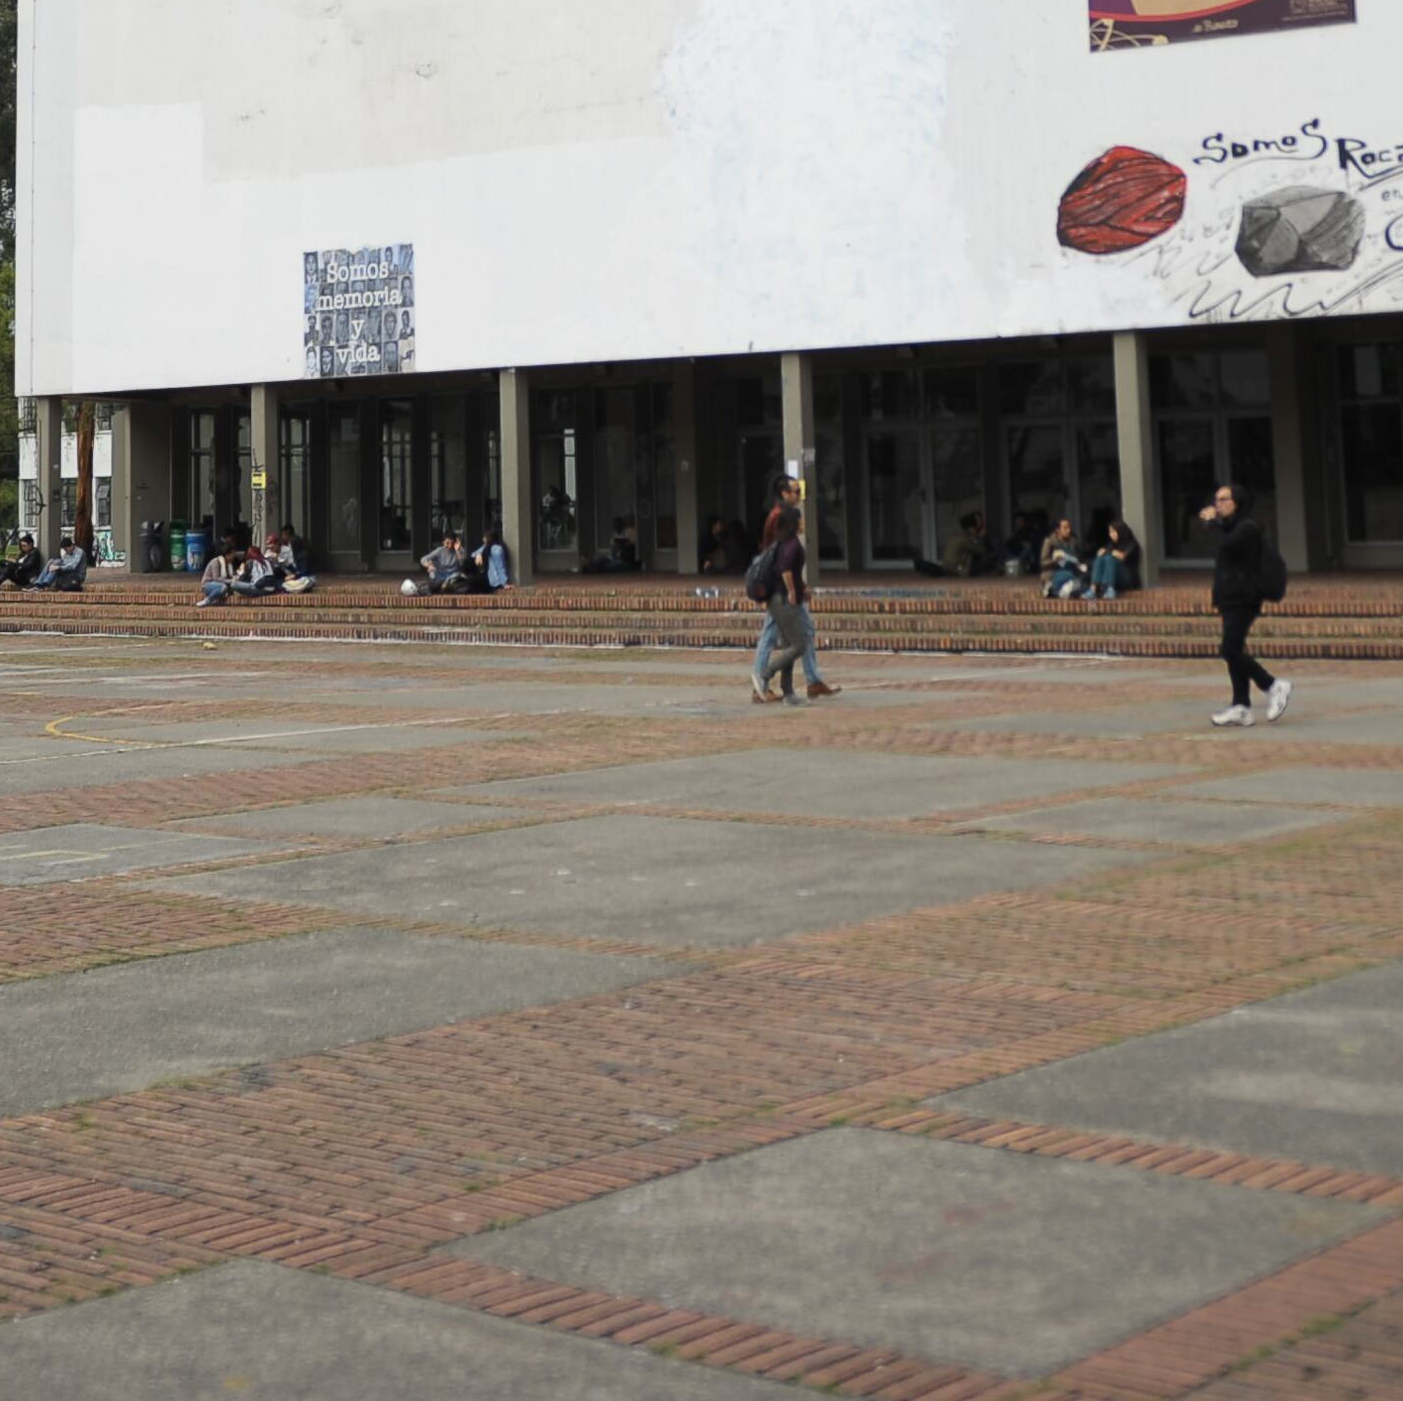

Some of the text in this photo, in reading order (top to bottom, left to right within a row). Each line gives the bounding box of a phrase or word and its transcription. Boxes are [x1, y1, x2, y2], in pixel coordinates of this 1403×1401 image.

[1381, 188, 1403, 202] en
[326, 261, 389, 283] Somos
[315, 286, 403, 311] memoria
[351, 319, 365, 339] y
[336, 341, 381, 363] vida
